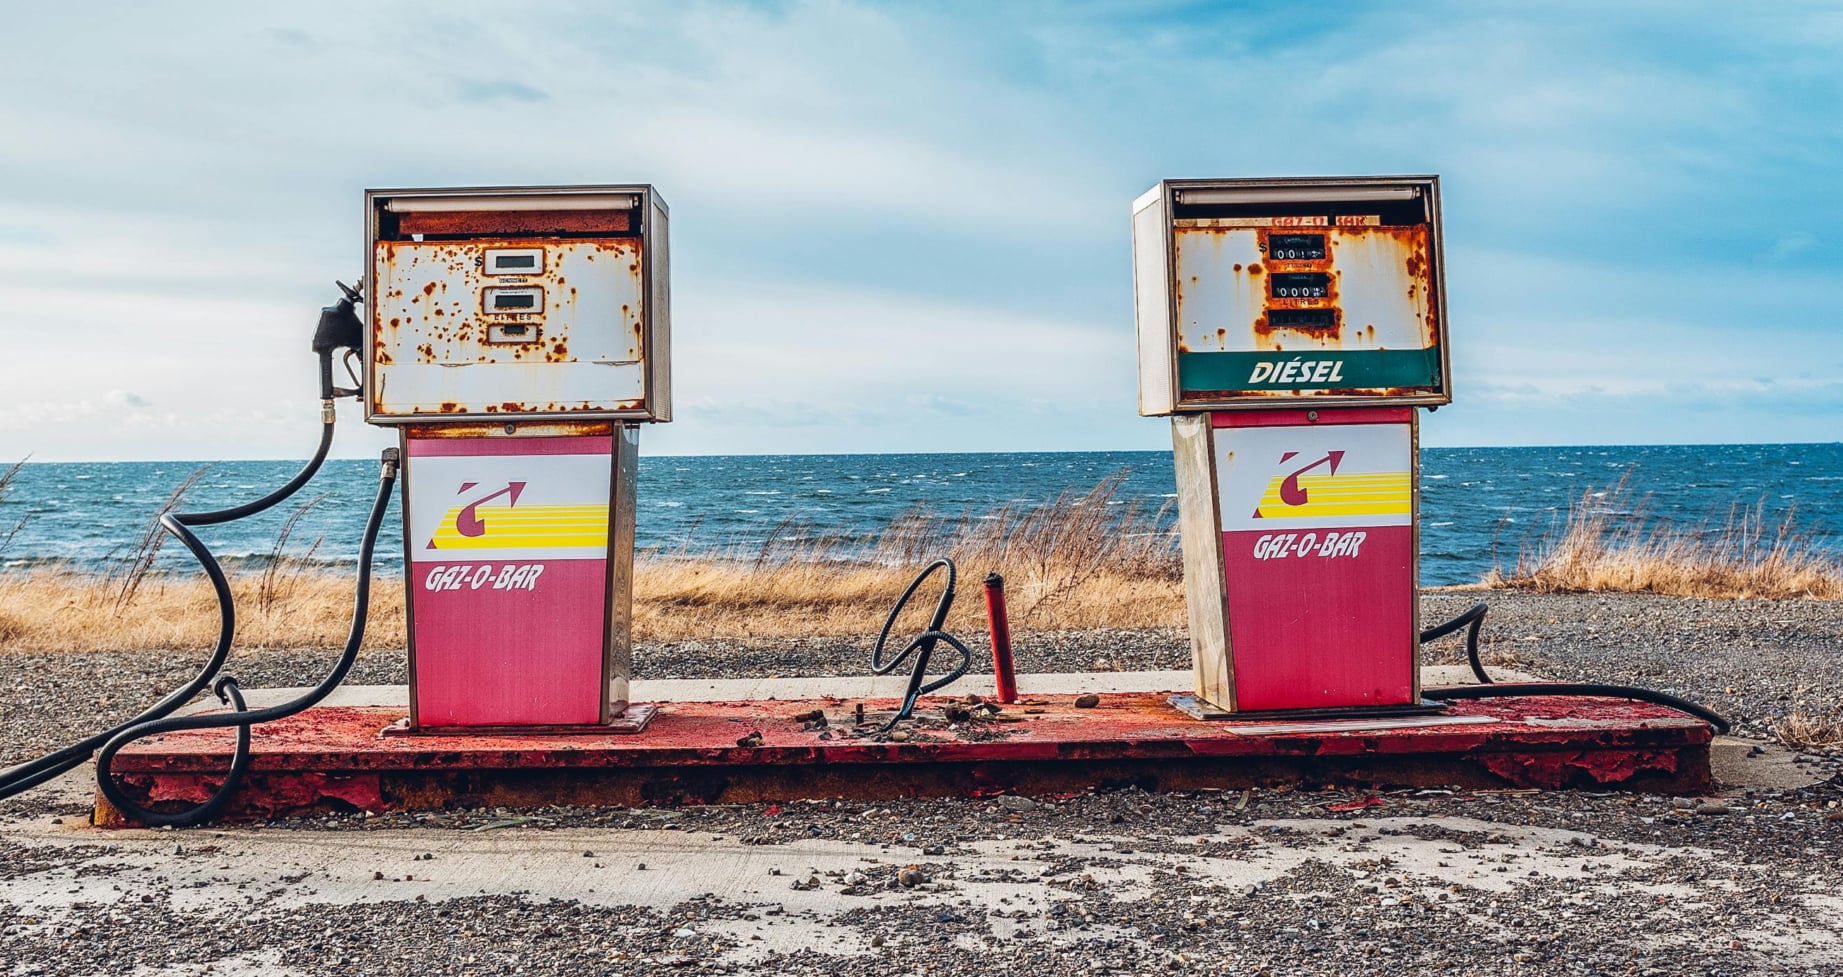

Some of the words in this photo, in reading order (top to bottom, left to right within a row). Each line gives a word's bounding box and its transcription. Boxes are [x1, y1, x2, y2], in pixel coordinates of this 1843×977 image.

[474, 255, 482, 267] $
[1248, 356, 1344, 384] DIÉSEL
[1252, 531, 1367, 561] GAZ-O-BAR
[425, 564, 545, 592] GAZ-O-BAR
